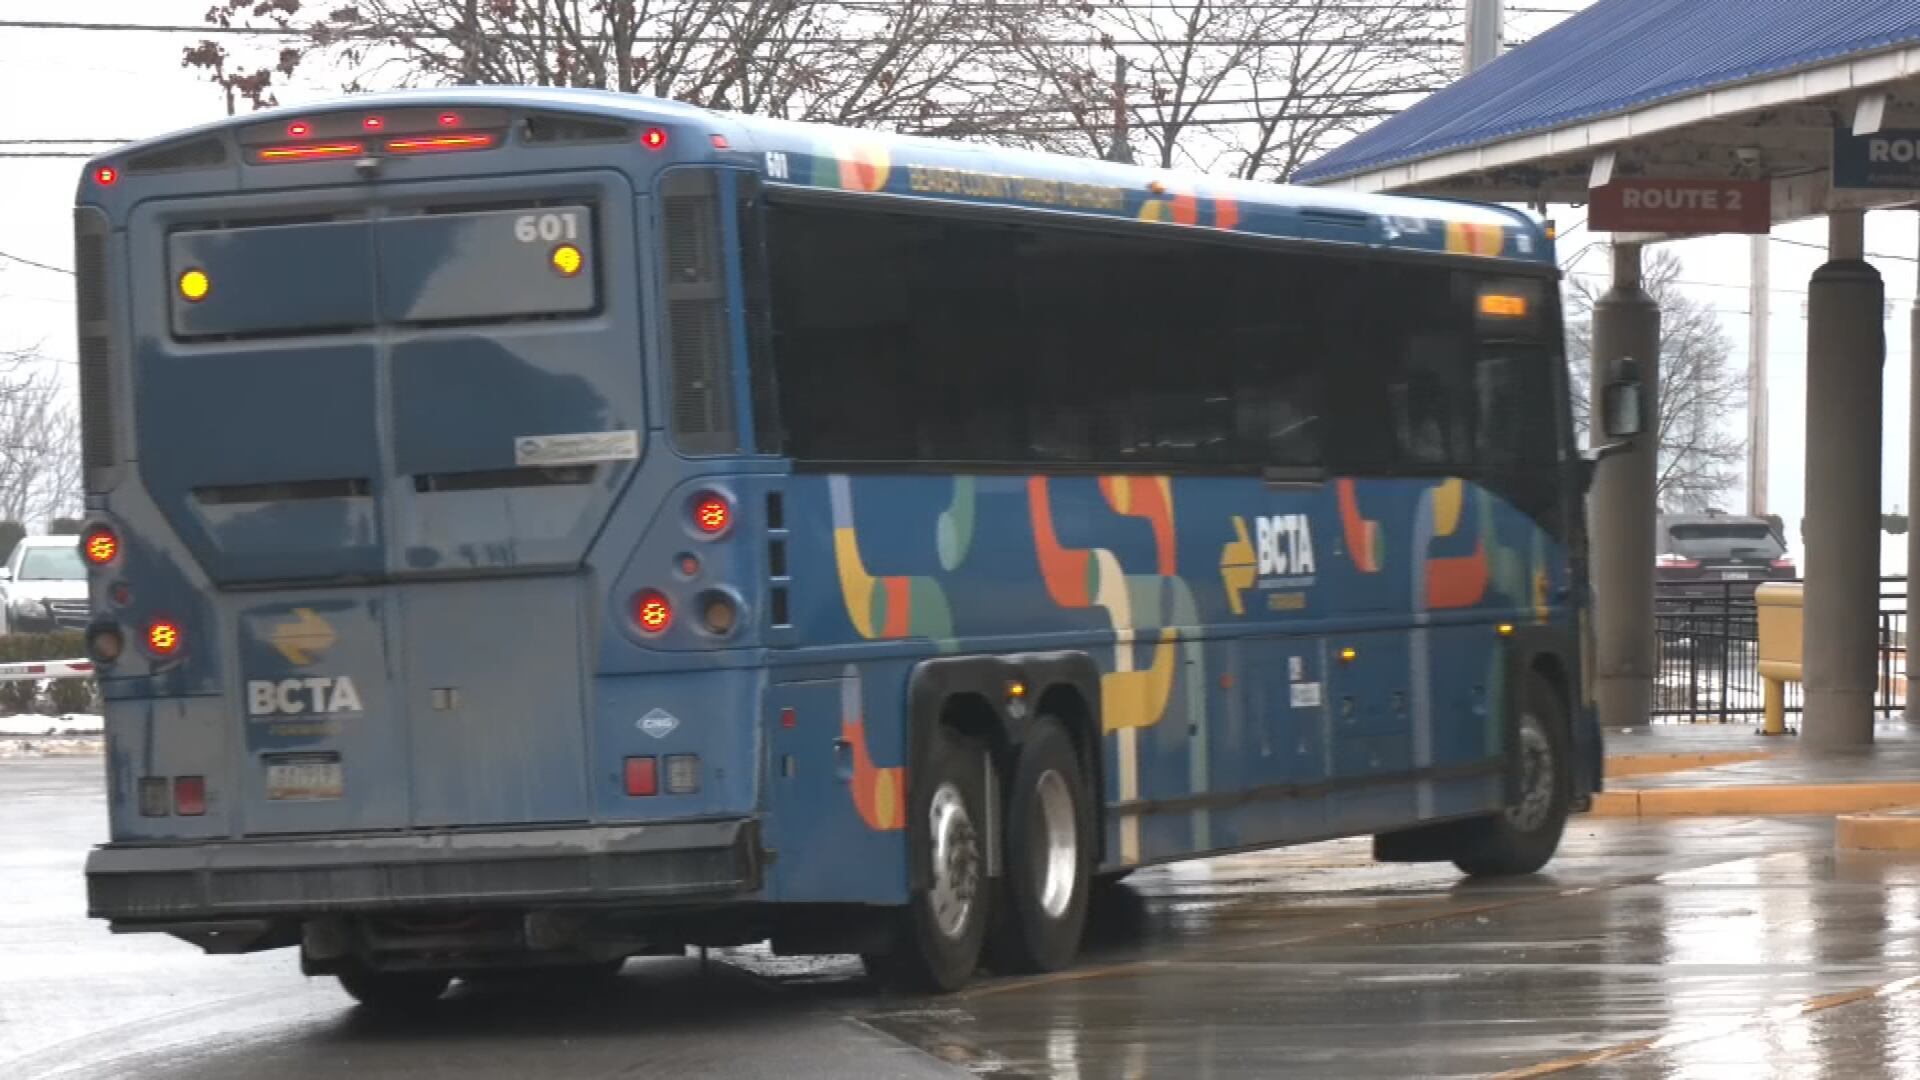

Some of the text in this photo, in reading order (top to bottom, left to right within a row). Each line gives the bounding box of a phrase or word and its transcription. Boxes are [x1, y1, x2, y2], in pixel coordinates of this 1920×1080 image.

[1868, 139, 1920, 162] RO
[1621, 188, 1743, 210] ROUTE 2
[514, 213, 578, 243] 601
[1255, 513, 1316, 575] BCTA
[247, 675, 363, 715] BCTA
